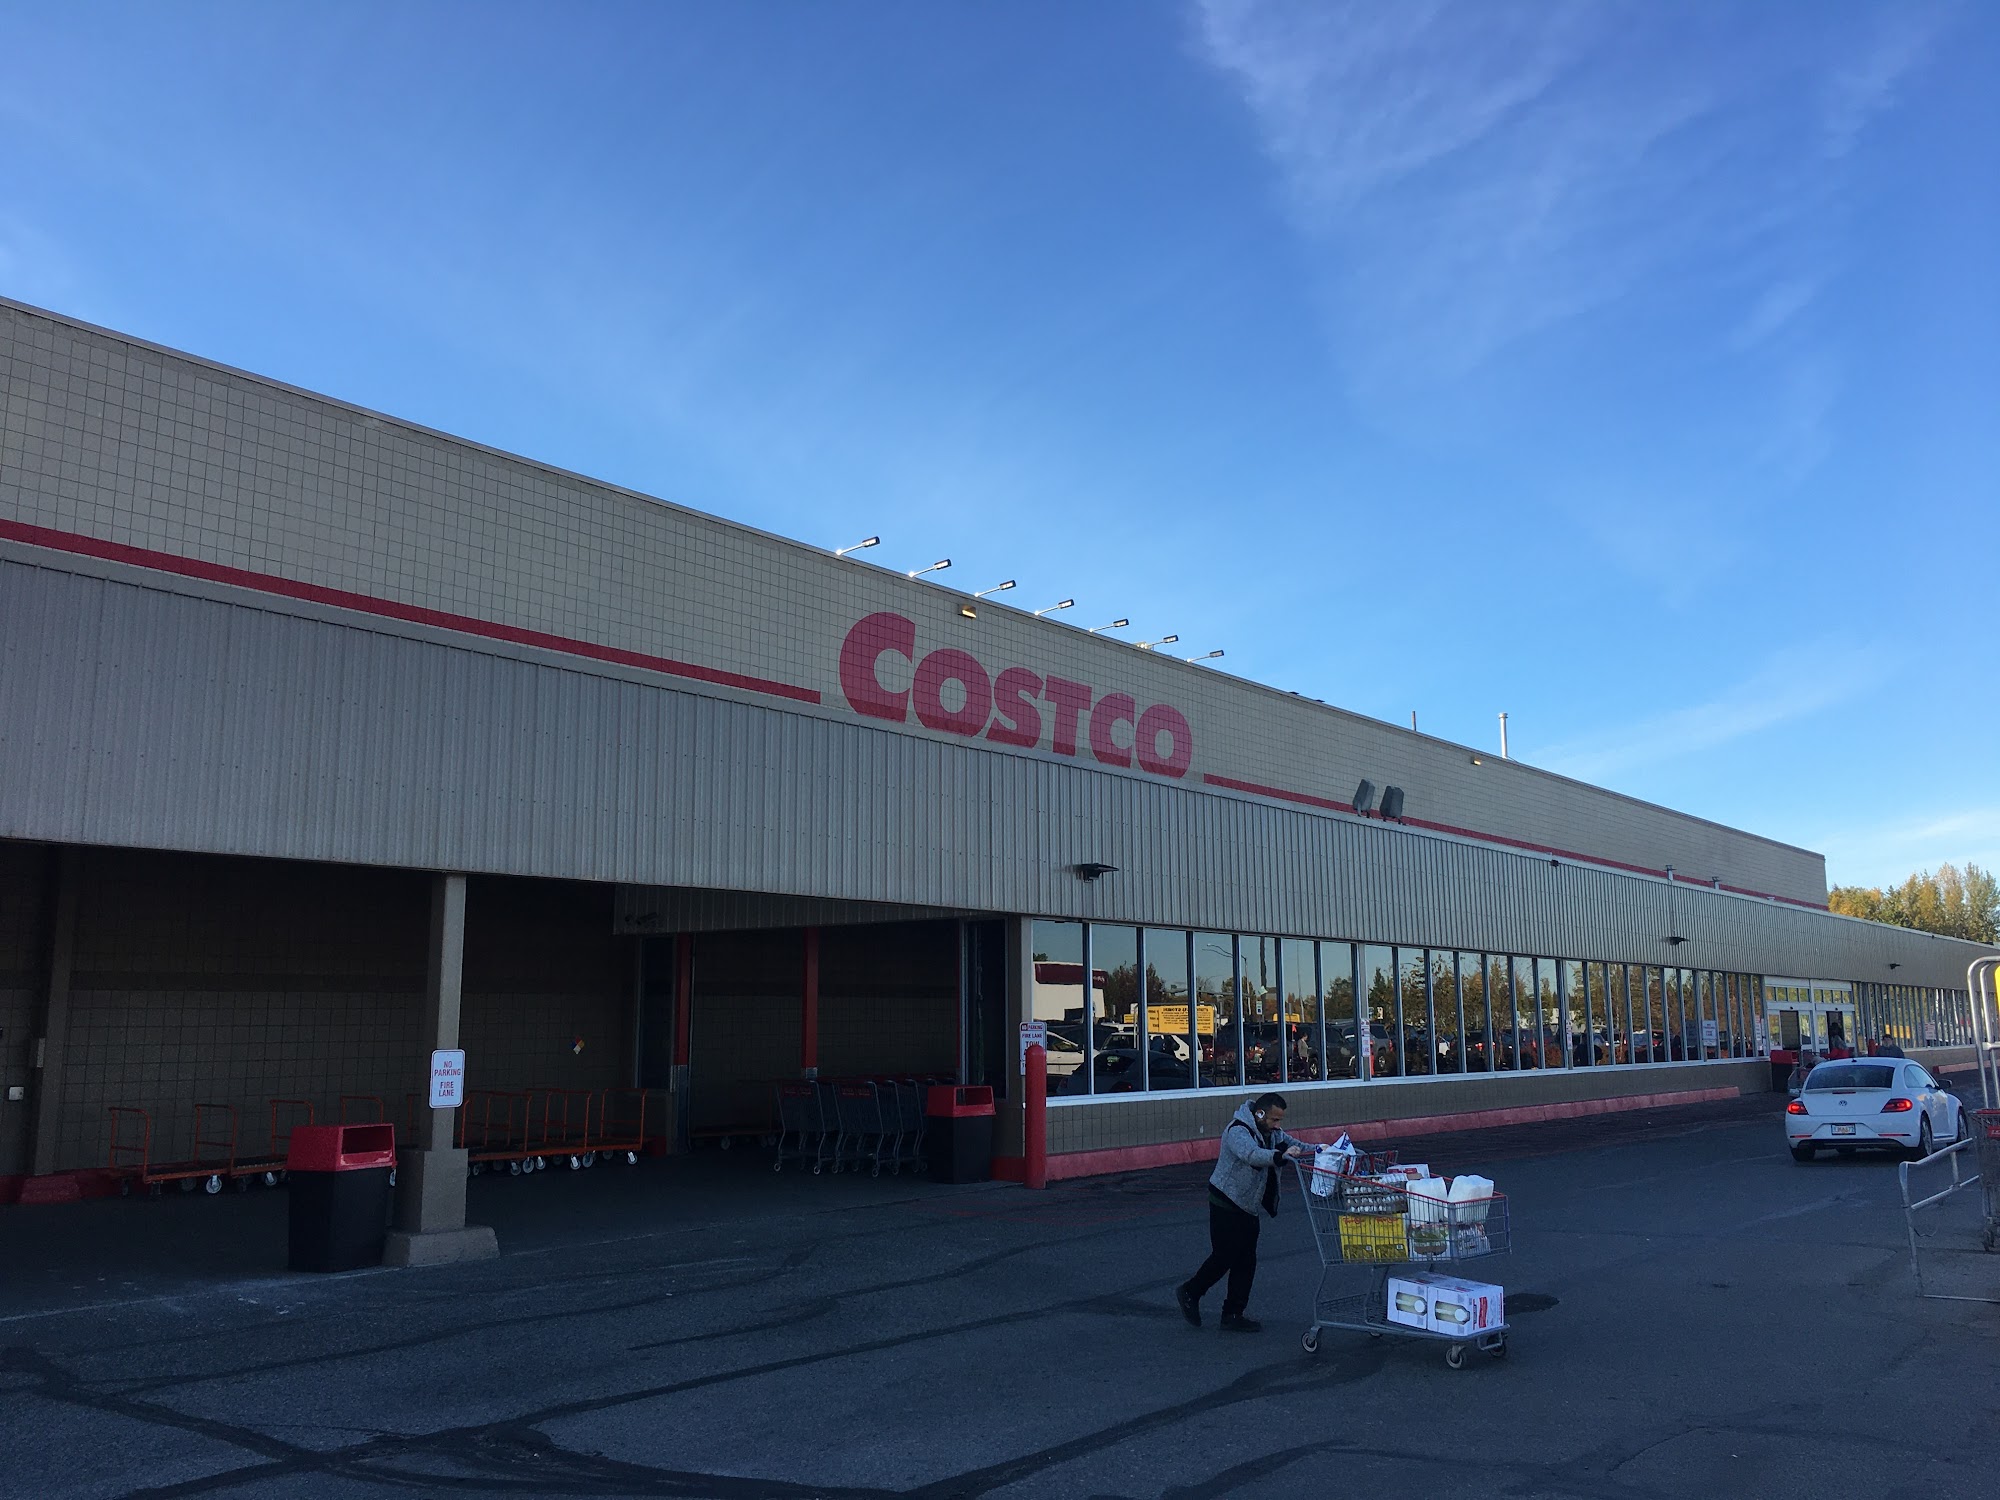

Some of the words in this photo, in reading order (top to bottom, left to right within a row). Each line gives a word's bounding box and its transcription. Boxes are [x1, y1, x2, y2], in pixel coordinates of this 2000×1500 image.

[839, 611, 1192, 779] COSTCO
[444, 1060, 452, 1068] NO
[434, 1068, 461, 1076] PARKING
